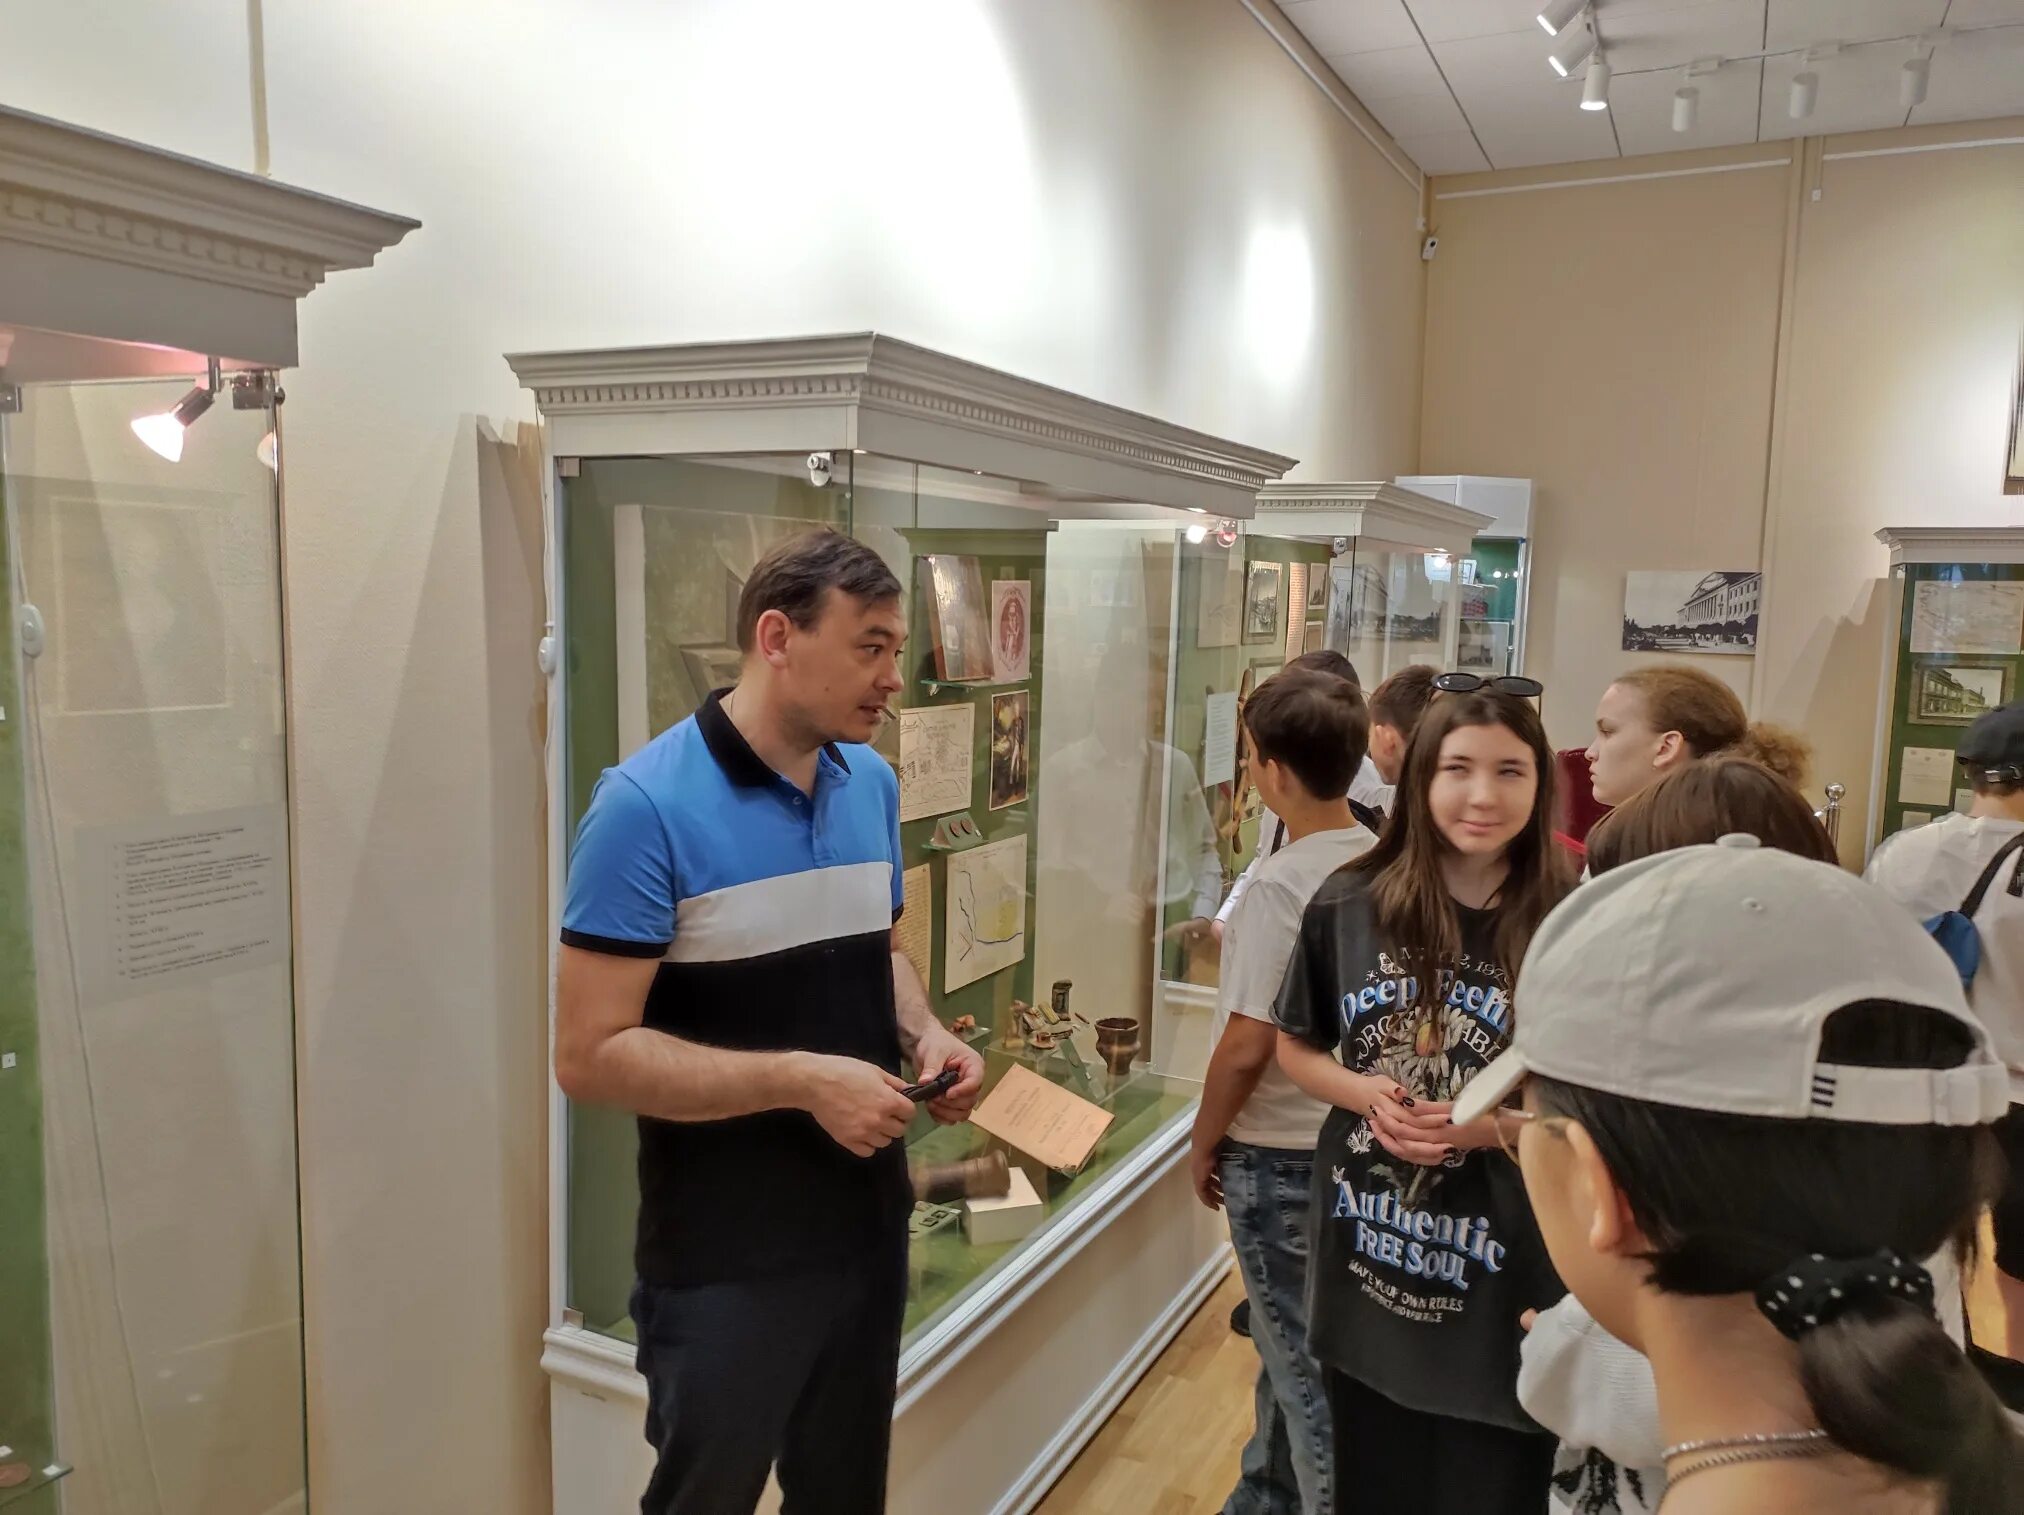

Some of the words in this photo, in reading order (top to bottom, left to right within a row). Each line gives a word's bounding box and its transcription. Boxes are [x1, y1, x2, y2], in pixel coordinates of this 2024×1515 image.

[1340, 976, 1418, 1033] Deep
[1331, 1180, 1507, 1273] Authentic
[1355, 1219, 1405, 1269] FREE
[1401, 1291, 1428, 1310] OWN
[1428, 1296, 1465, 1313] RULES
